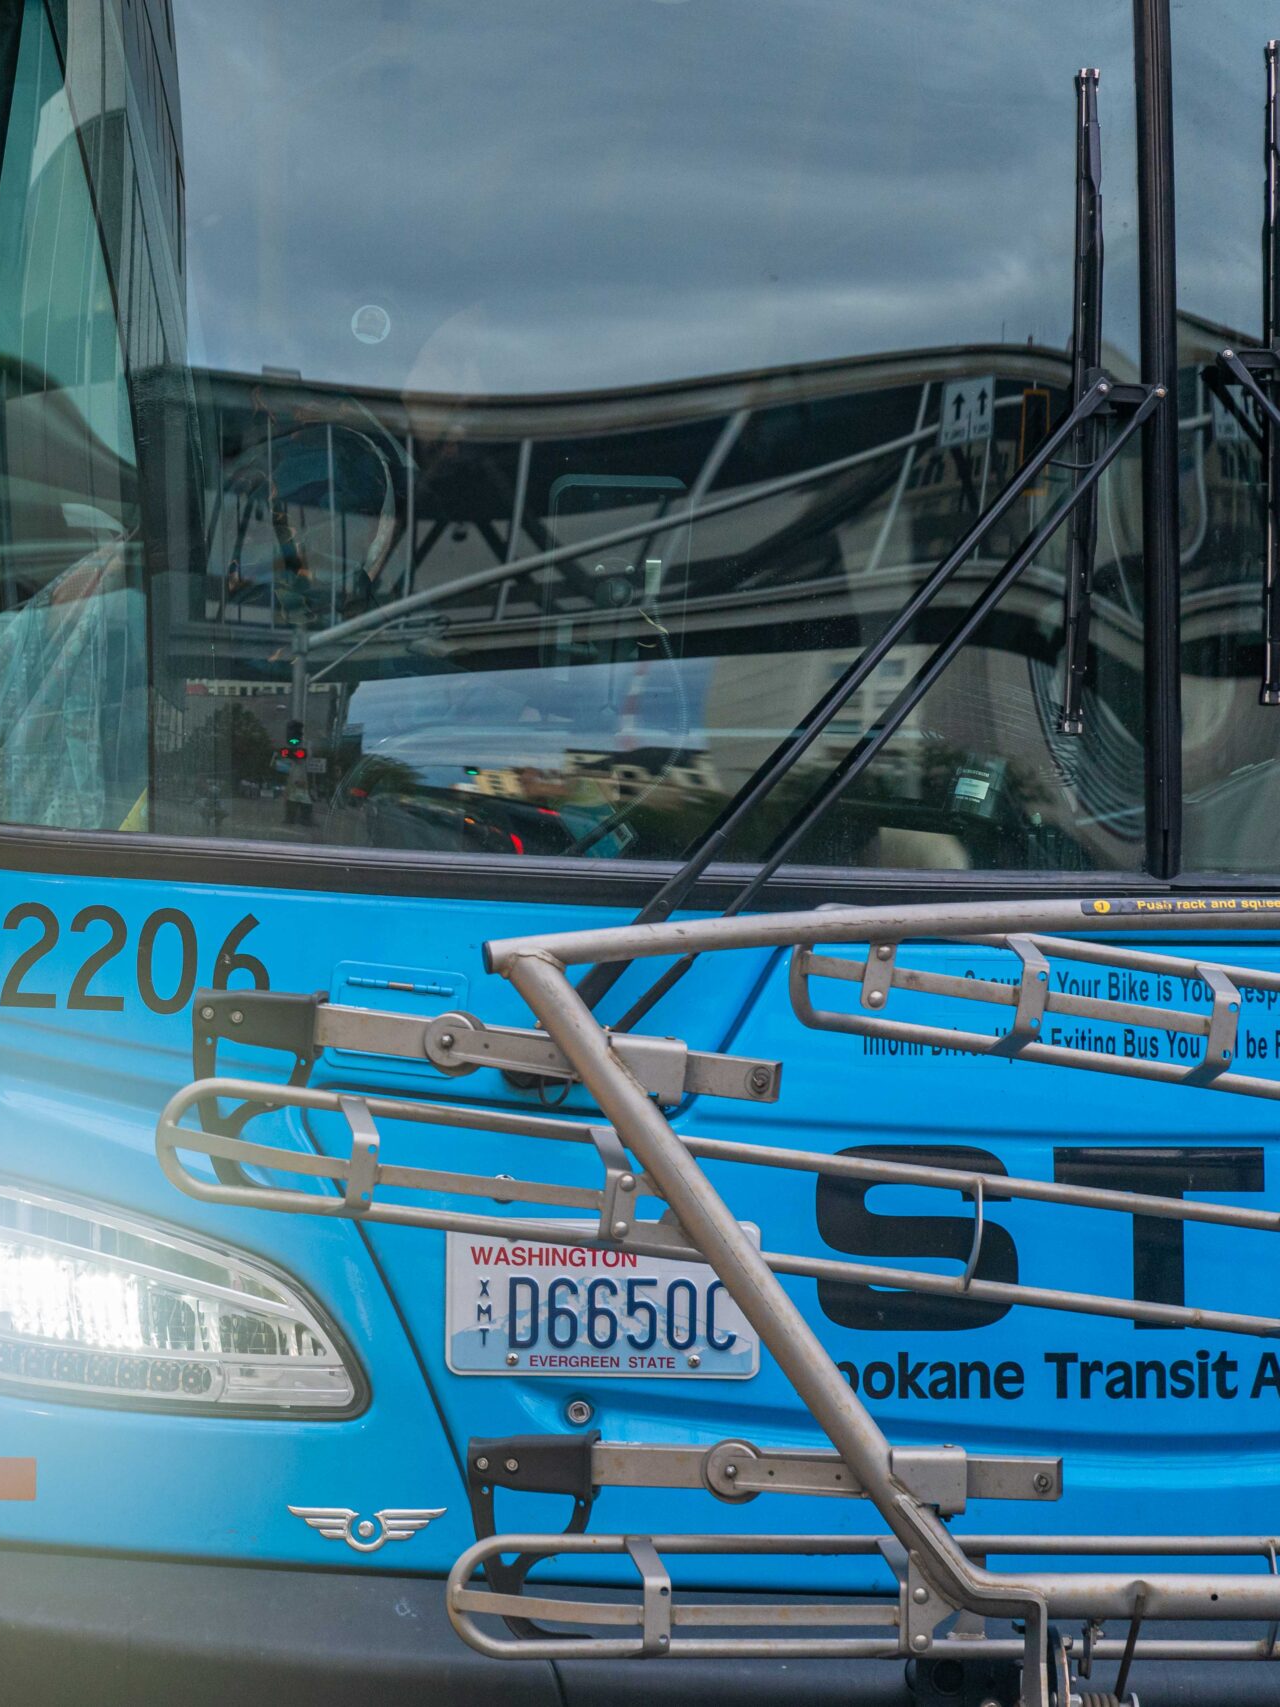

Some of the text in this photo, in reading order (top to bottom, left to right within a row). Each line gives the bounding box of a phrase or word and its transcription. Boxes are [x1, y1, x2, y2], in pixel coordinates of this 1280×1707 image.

[1176, 899, 1207, 909] rack
[1211, 899, 1236, 908] and
[0, 902, 271, 1016] 2206
[1057, 971, 1279, 1010] Your Bike is You esp
[1124, 1029, 1159, 1059] Bus
[1166, 1029, 1201, 1059] You
[1246, 1029, 1268, 1059] be
[816, 1144, 1265, 1331] ST
[470, 1246, 637, 1268] WASHINGTON
[529, 1355, 676, 1370] EVERGREEN STATE
[1044, 1349, 1239, 1400] Transit
[1249, 1351, 1280, 1399] A
